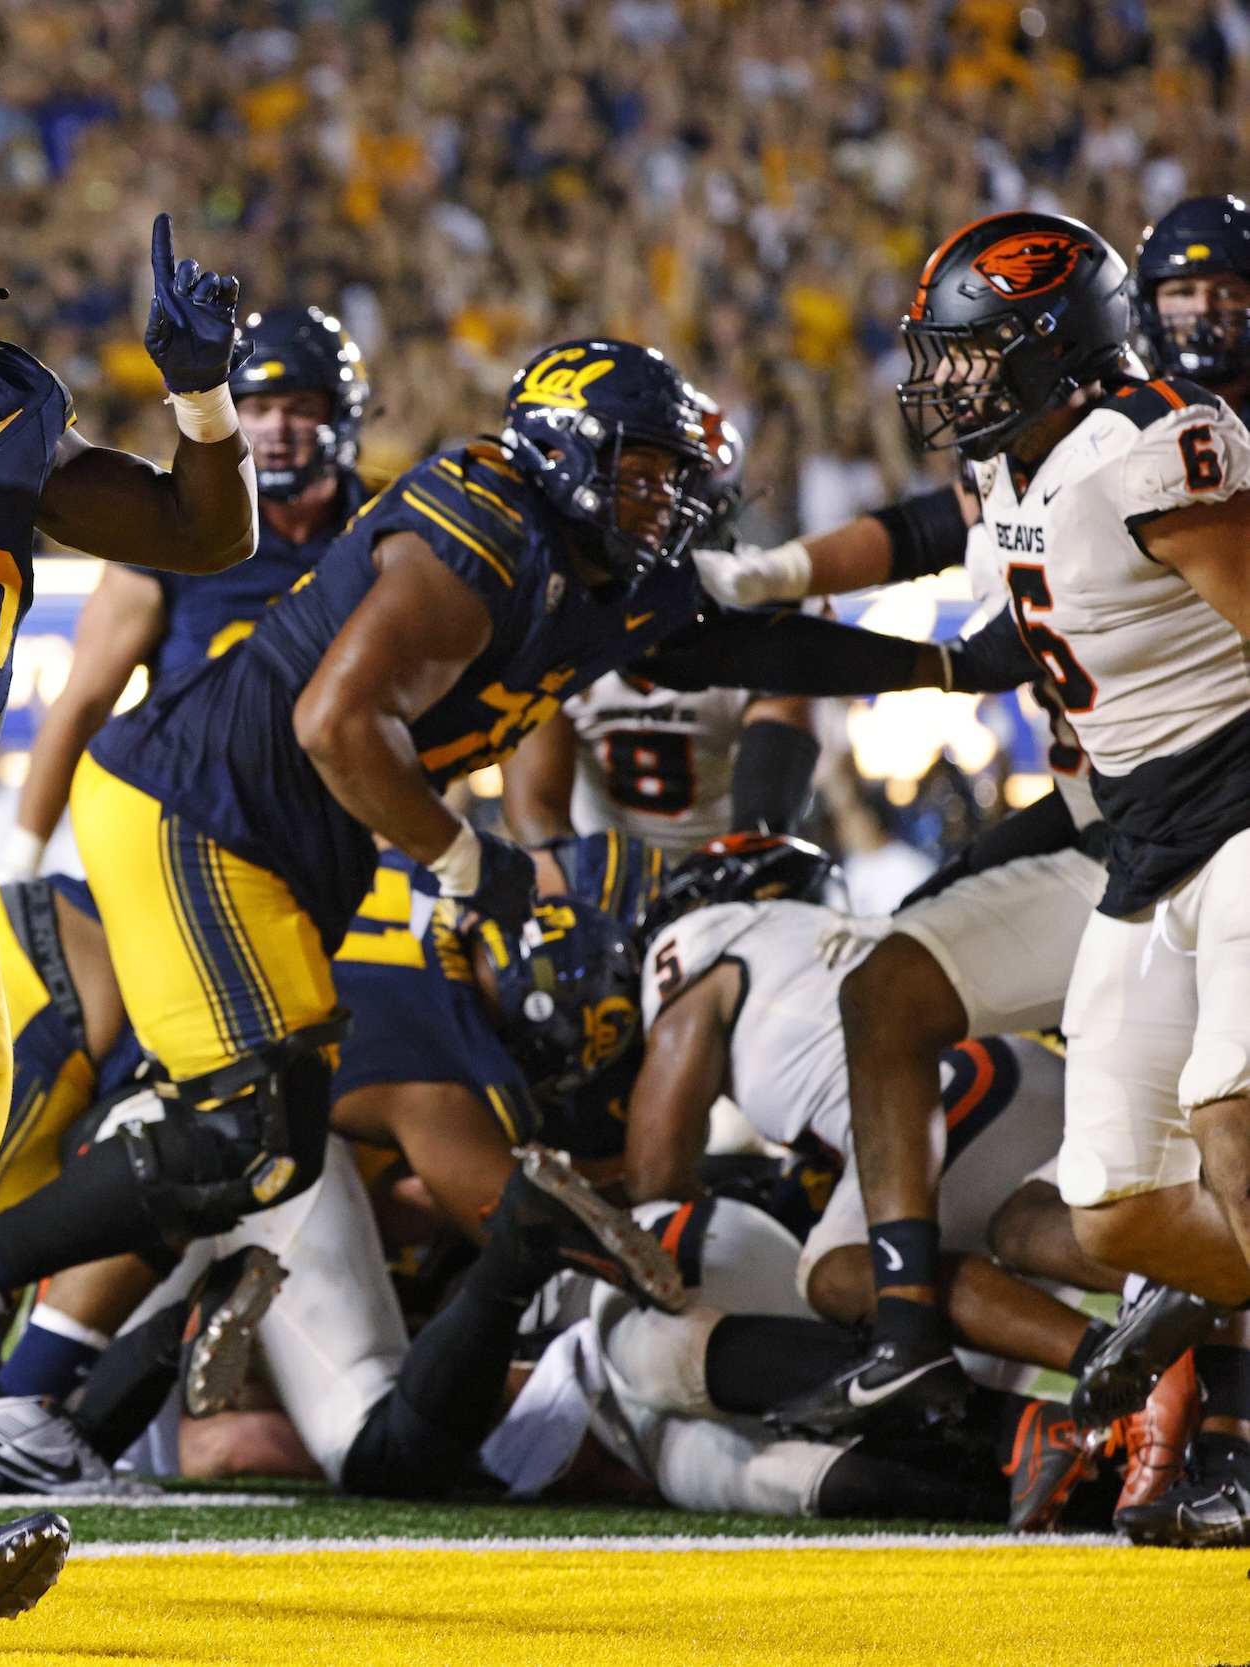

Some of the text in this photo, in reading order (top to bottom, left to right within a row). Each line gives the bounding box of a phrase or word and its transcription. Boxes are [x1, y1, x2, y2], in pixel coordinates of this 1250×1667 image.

[516, 347, 616, 410] Cal
[1178, 424, 1224, 494] 6
[996, 522, 1045, 554] BEAVS
[1007, 562, 1098, 714] 6
[607, 728, 697, 820] 8
